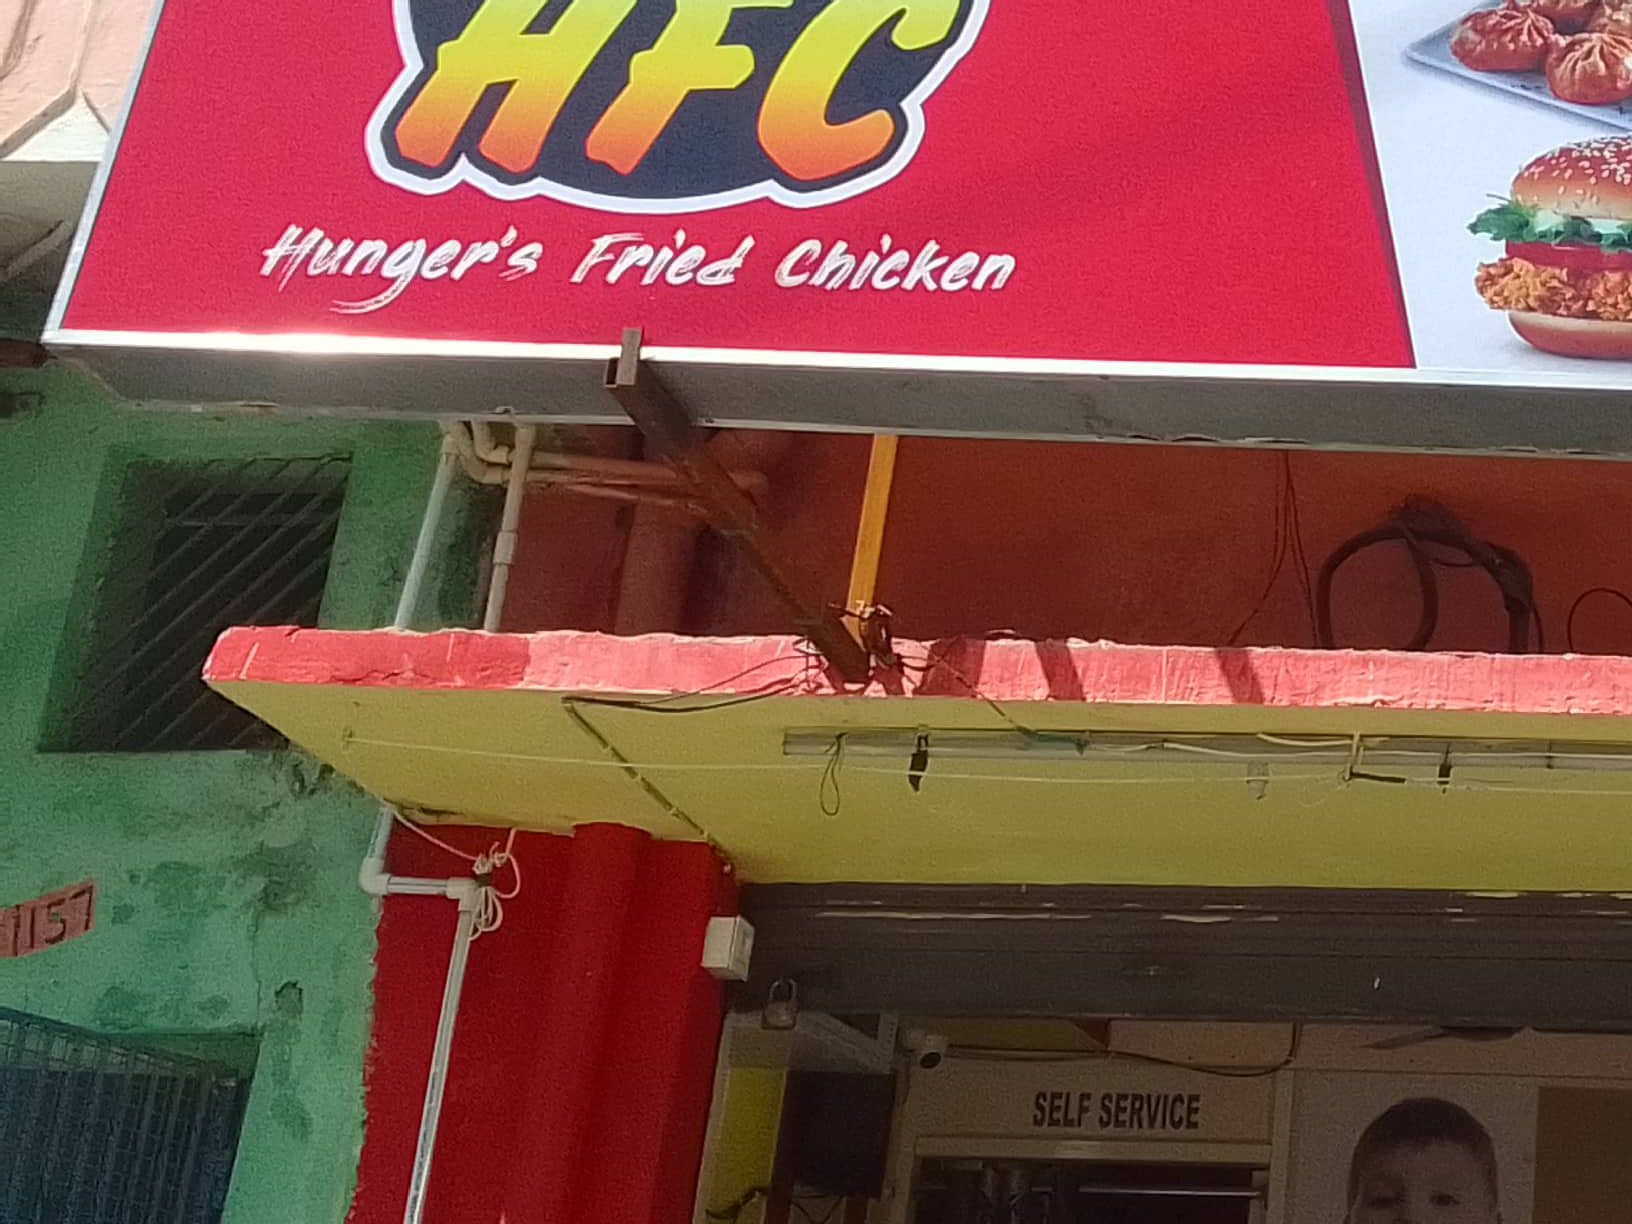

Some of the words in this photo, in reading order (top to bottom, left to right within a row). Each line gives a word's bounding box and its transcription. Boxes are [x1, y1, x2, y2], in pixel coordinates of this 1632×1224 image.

[260, 222, 543, 314] Hunger's
[569, 227, 756, 288] Fried
[774, 233, 1017, 293] Chicken
[1032, 1091, 1092, 1128] SELF
[1099, 1092, 1201, 1129] SERVICE
